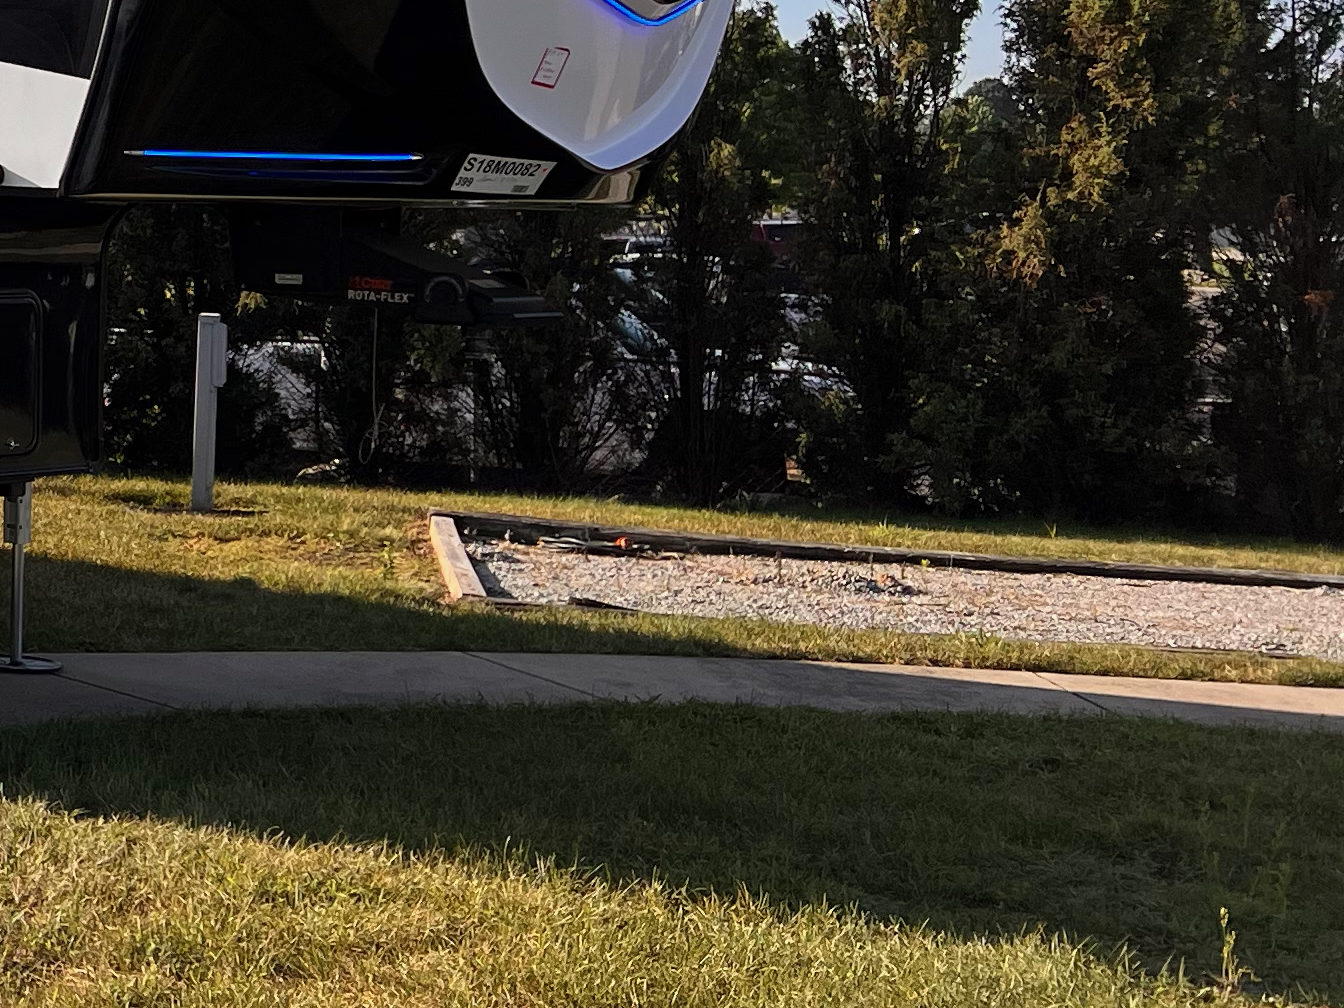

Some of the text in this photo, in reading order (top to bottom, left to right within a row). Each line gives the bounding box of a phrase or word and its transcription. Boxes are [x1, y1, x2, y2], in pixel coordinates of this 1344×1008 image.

[463, 157, 541, 176] S18M0082
[455, 176, 474, 187] 399
[347, 289, 409, 304] ROTA-FLEX
